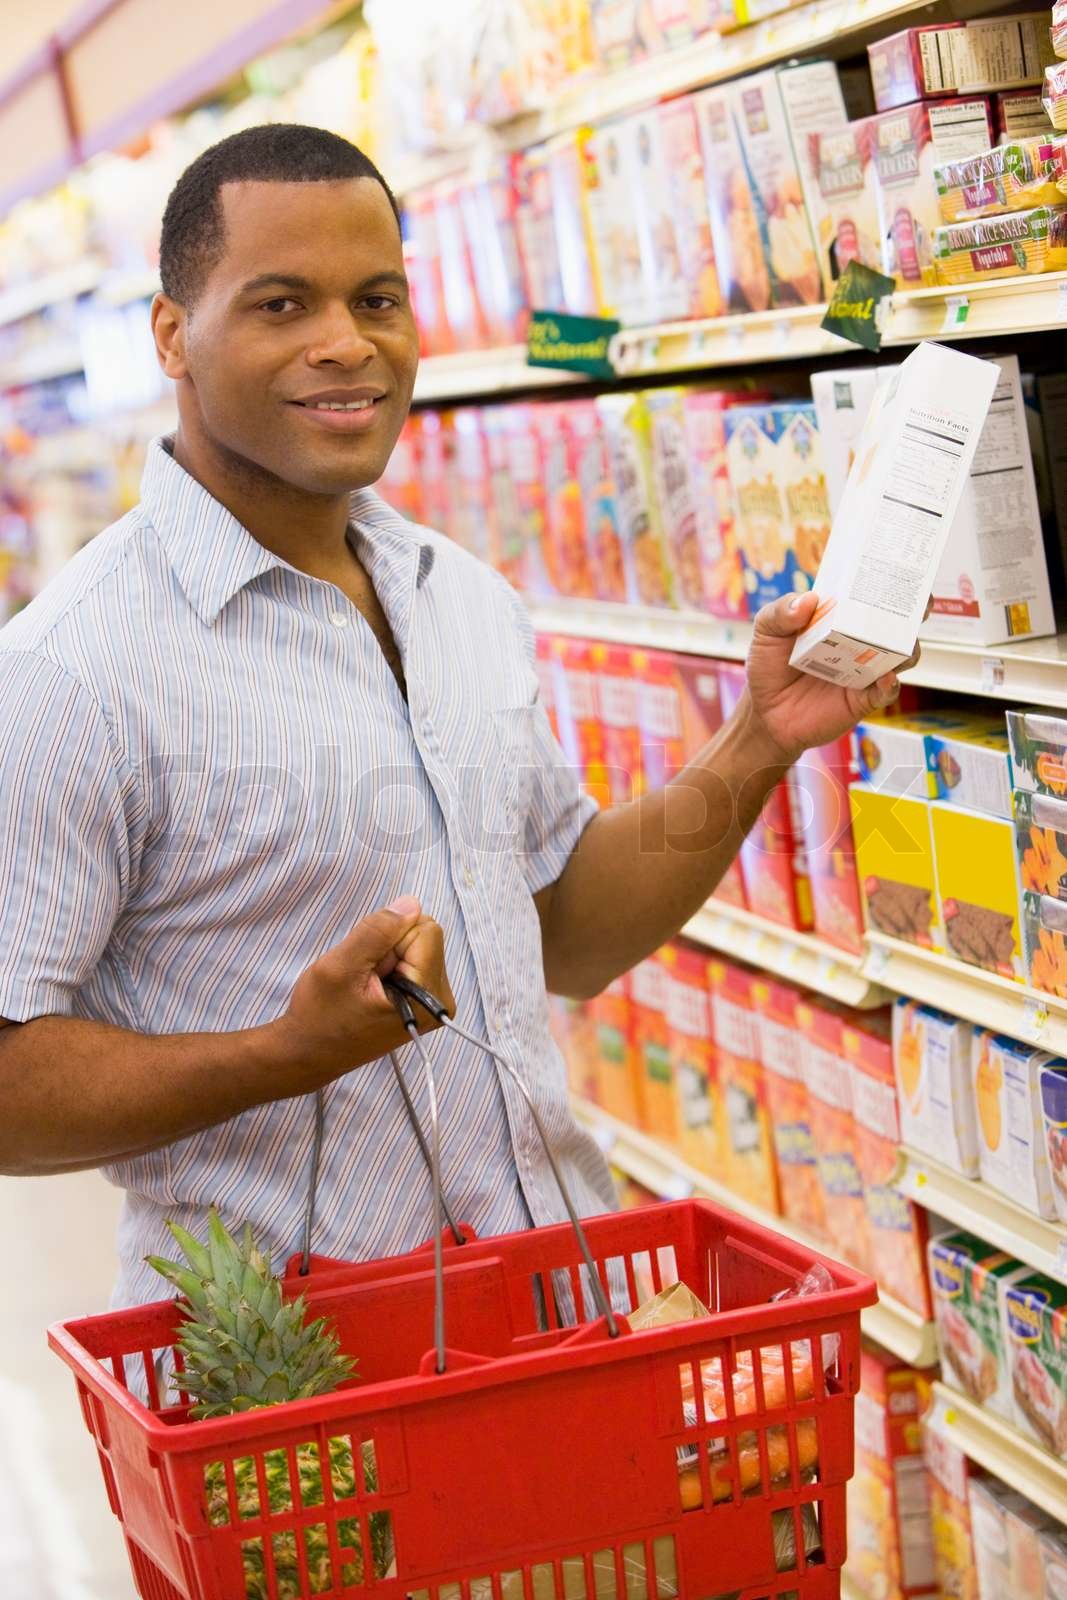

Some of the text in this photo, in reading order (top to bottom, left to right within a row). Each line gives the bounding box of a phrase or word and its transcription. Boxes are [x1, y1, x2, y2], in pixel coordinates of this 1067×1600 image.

[931, 103, 985, 115] Nutrition Facts
[979, 221, 1000, 244] RICE
[1000, 218, 1029, 241] SNAPS
[975, 248, 1009, 269] Vegetable
[910, 407, 969, 433] Nutrition Facts
